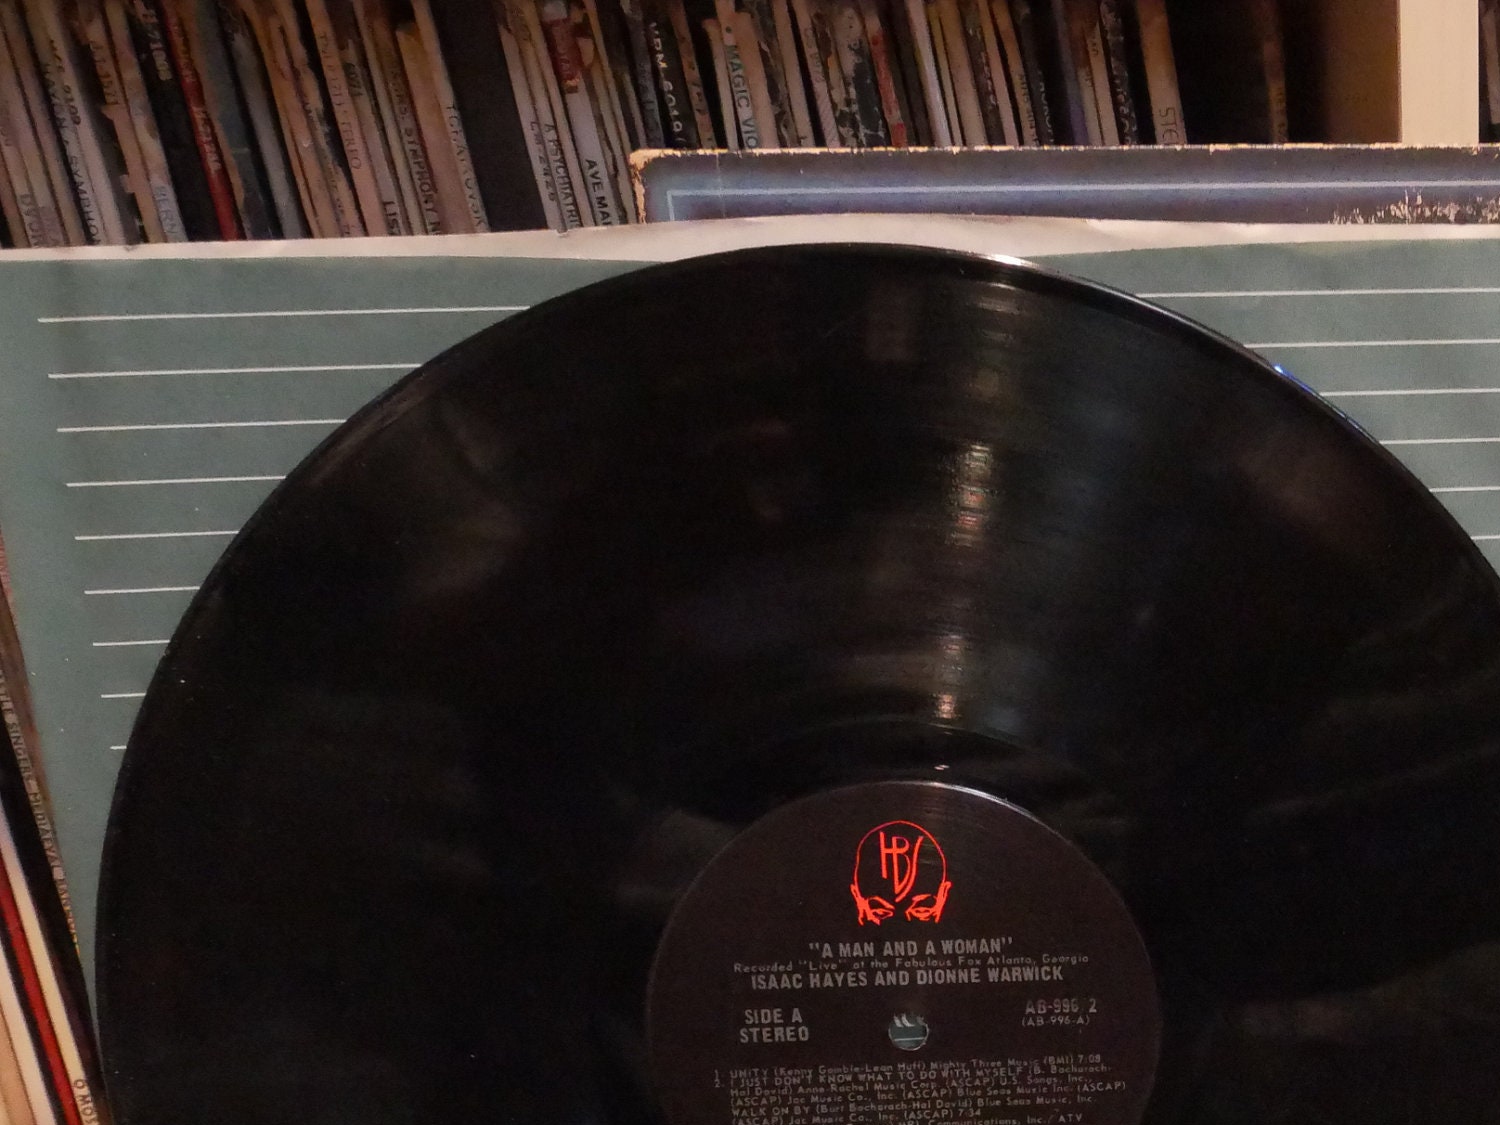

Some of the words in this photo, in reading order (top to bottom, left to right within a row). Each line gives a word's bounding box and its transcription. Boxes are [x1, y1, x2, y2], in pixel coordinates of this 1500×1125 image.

[725, 43, 752, 108] MAGIC
[585, 159, 605, 193] AVE
[810, 942, 834, 959] "A
[839, 941, 875, 958] MAN
[883, 940, 917, 957] AND
[925, 940, 936, 956] A
[941, 937, 1013, 955] WOMAN"
[734, 962, 794, 974] Recorded
[799, 959, 847, 971] "Live"
[852, 960, 866, 969] at
[870, 958, 892, 969] the
[895, 956, 952, 968] Fabulous
[958, 956, 982, 967] Fox
[987, 955, 1037, 968] Atlanta,
[1042, 953, 1089, 965] Georgia
[752, 974, 803, 990] ISAAC
[810, 972, 868, 988] HAYES
[875, 970, 909, 987] AND
[916, 969, 981, 985] DIONNE
[987, 965, 1063, 984] WARWICK
[745, 1008, 785, 1024] SIDE
[790, 1008, 803, 1023] A
[1021, 1015, 1090, 1027] (AB-996-A)
[739, 1026, 810, 1044] STEREO
[714, 1079, 725, 1088] 2.
[740, 1078, 767, 1087] JUST
[819, 1074, 853, 1083] KNOW
[858, 1072, 892, 1081] WHAT
[900, 1071, 914, 1080] TO
[920, 1070, 936, 1079] DO
[942, 1069, 970, 1078] WITH
[976, 1067, 1023, 1077] MYSELF
[730, 1069, 768, 1079] UNITY
[774, 1068, 813, 1078] (Kenny
[897, 1062, 926, 1072] Huff)
[930, 1061, 966, 1071] Mighty
[971, 1059, 1002, 1068] Three
[1008, 1057, 1039, 1067] Music
[1043, 1055, 1074, 1065] (BMI)
[72, 1078, 83, 1091] O
[731, 1089, 752, 1097] Hal
[755, 1086, 793, 1096] David)
[874, 1082, 906, 1091] Music
[945, 1077, 996, 1088] (ASCAP)
[1000, 1076, 1020, 1086] U.S.
[731, 1096, 782, 1107] (ASCAP)
[788, 1096, 806, 1105] Jac
[811, 1094, 844, 1104] Music
[903, 1088, 953, 1100] (ASCAP)
[957, 1088, 982, 1097] Blue
[987, 1087, 1012, 1096] Seas
[1016, 1085, 1050, 1095] Music
[1077, 1081, 1126, 1092] (ASCAP)
[731, 1107, 766, 1117] WALK
[772, 1106, 789, 1115] ON
[794, 1106, 810, 1115] BY
[815, 1104, 845, 1114] (Burt
[936, 1097, 972, 1108] David)
[977, 1097, 1002, 1107] Blue
[1006, 1096, 1032, 1106] Seas
[789, 1116, 807, 1125] Jac
[812, 1115, 845, 1124] Music
[904, 1109, 953, 1120] (ASCAP)
[1058, 1113, 1083, 1123] ATV
